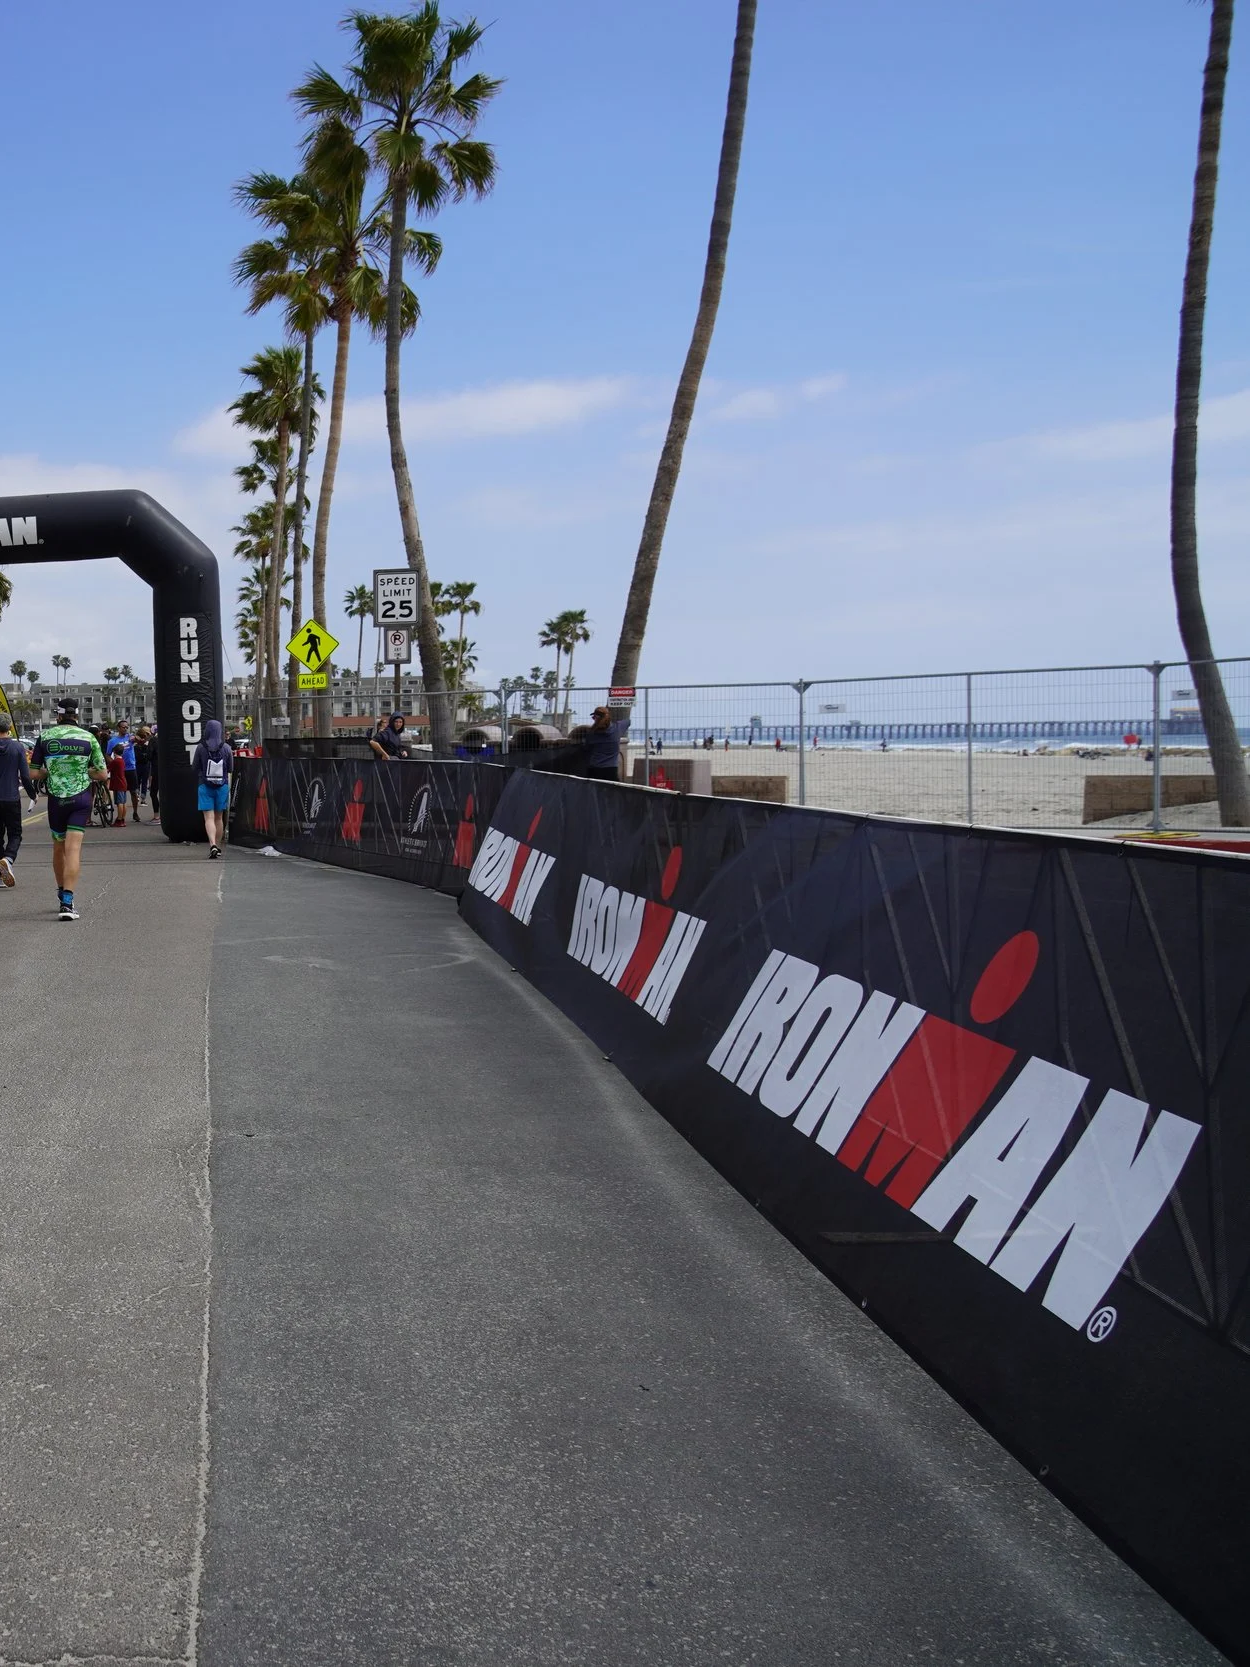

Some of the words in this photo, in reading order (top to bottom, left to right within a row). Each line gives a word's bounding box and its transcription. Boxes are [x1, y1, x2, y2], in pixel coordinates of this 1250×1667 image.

[380, 577, 415, 586] SPEED
[383, 589, 412, 597] LIMIT
[382, 600, 413, 619] 25
[179, 617, 200, 683] RUN
[301, 676, 325, 686] AHEAD
[566, 862, 708, 1026] IRONMAN
[706, 935, 1203, 1332] IRONMAN
